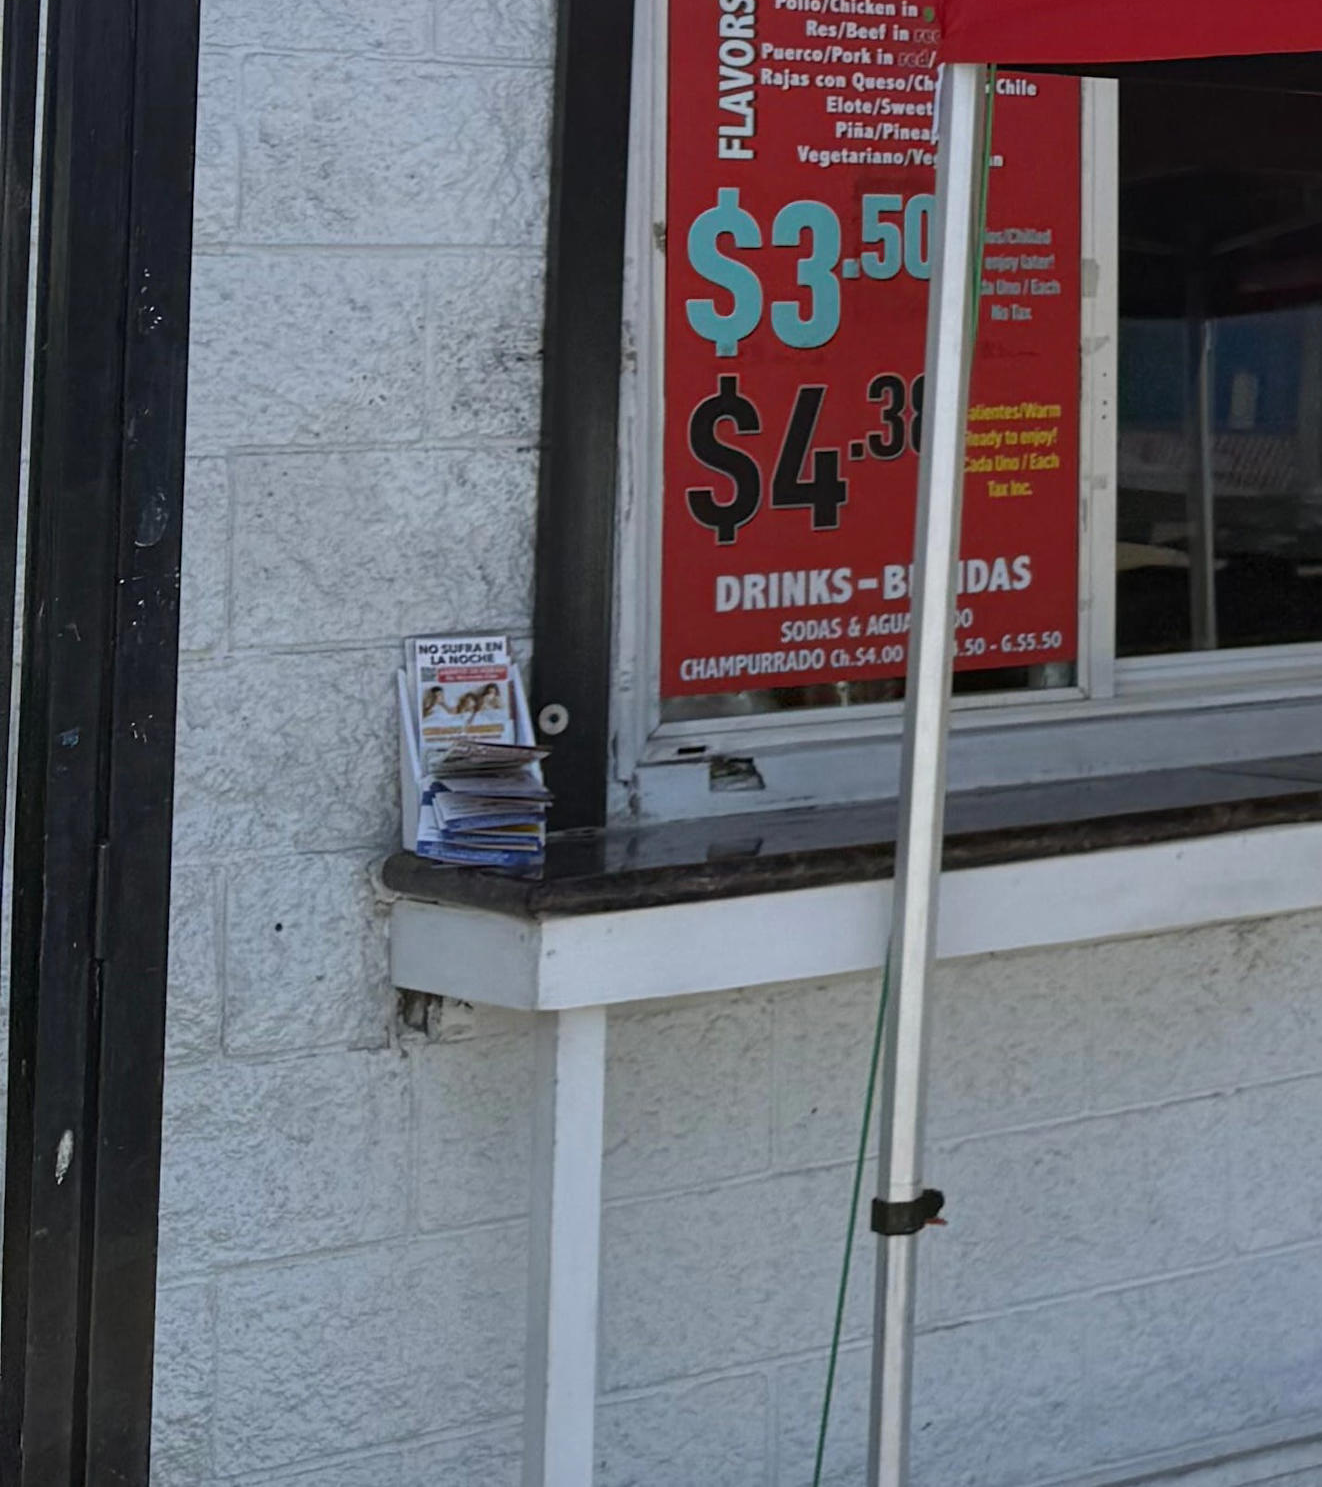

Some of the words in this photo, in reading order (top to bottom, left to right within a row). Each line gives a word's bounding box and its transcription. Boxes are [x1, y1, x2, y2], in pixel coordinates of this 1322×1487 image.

[902, 0, 919, 18] in
[805, 20, 887, 41] Res/Beef
[892, 24, 910, 40] in
[760, 42, 872, 65] Puerco/Pork
[876, 48, 894, 65] in
[760, 69, 810, 91] Rajas
[815, 74, 847, 89] con
[995, 78, 1038, 97] Chile
[825, 96, 934, 116] Elote/Sweet
[968, 402, 1062, 421] alientes/Warm
[780, 617, 842, 644] SODAS
[847, 616, 861, 637] &
[418, 643, 440, 655] NO
[440, 642, 482, 655] SUFRA
[486, 640, 503, 652] EN
[430, 655, 446, 665] LA
[448, 654, 495, 665] NOCHE
[679, 648, 825, 682] CHAMPURRADO
